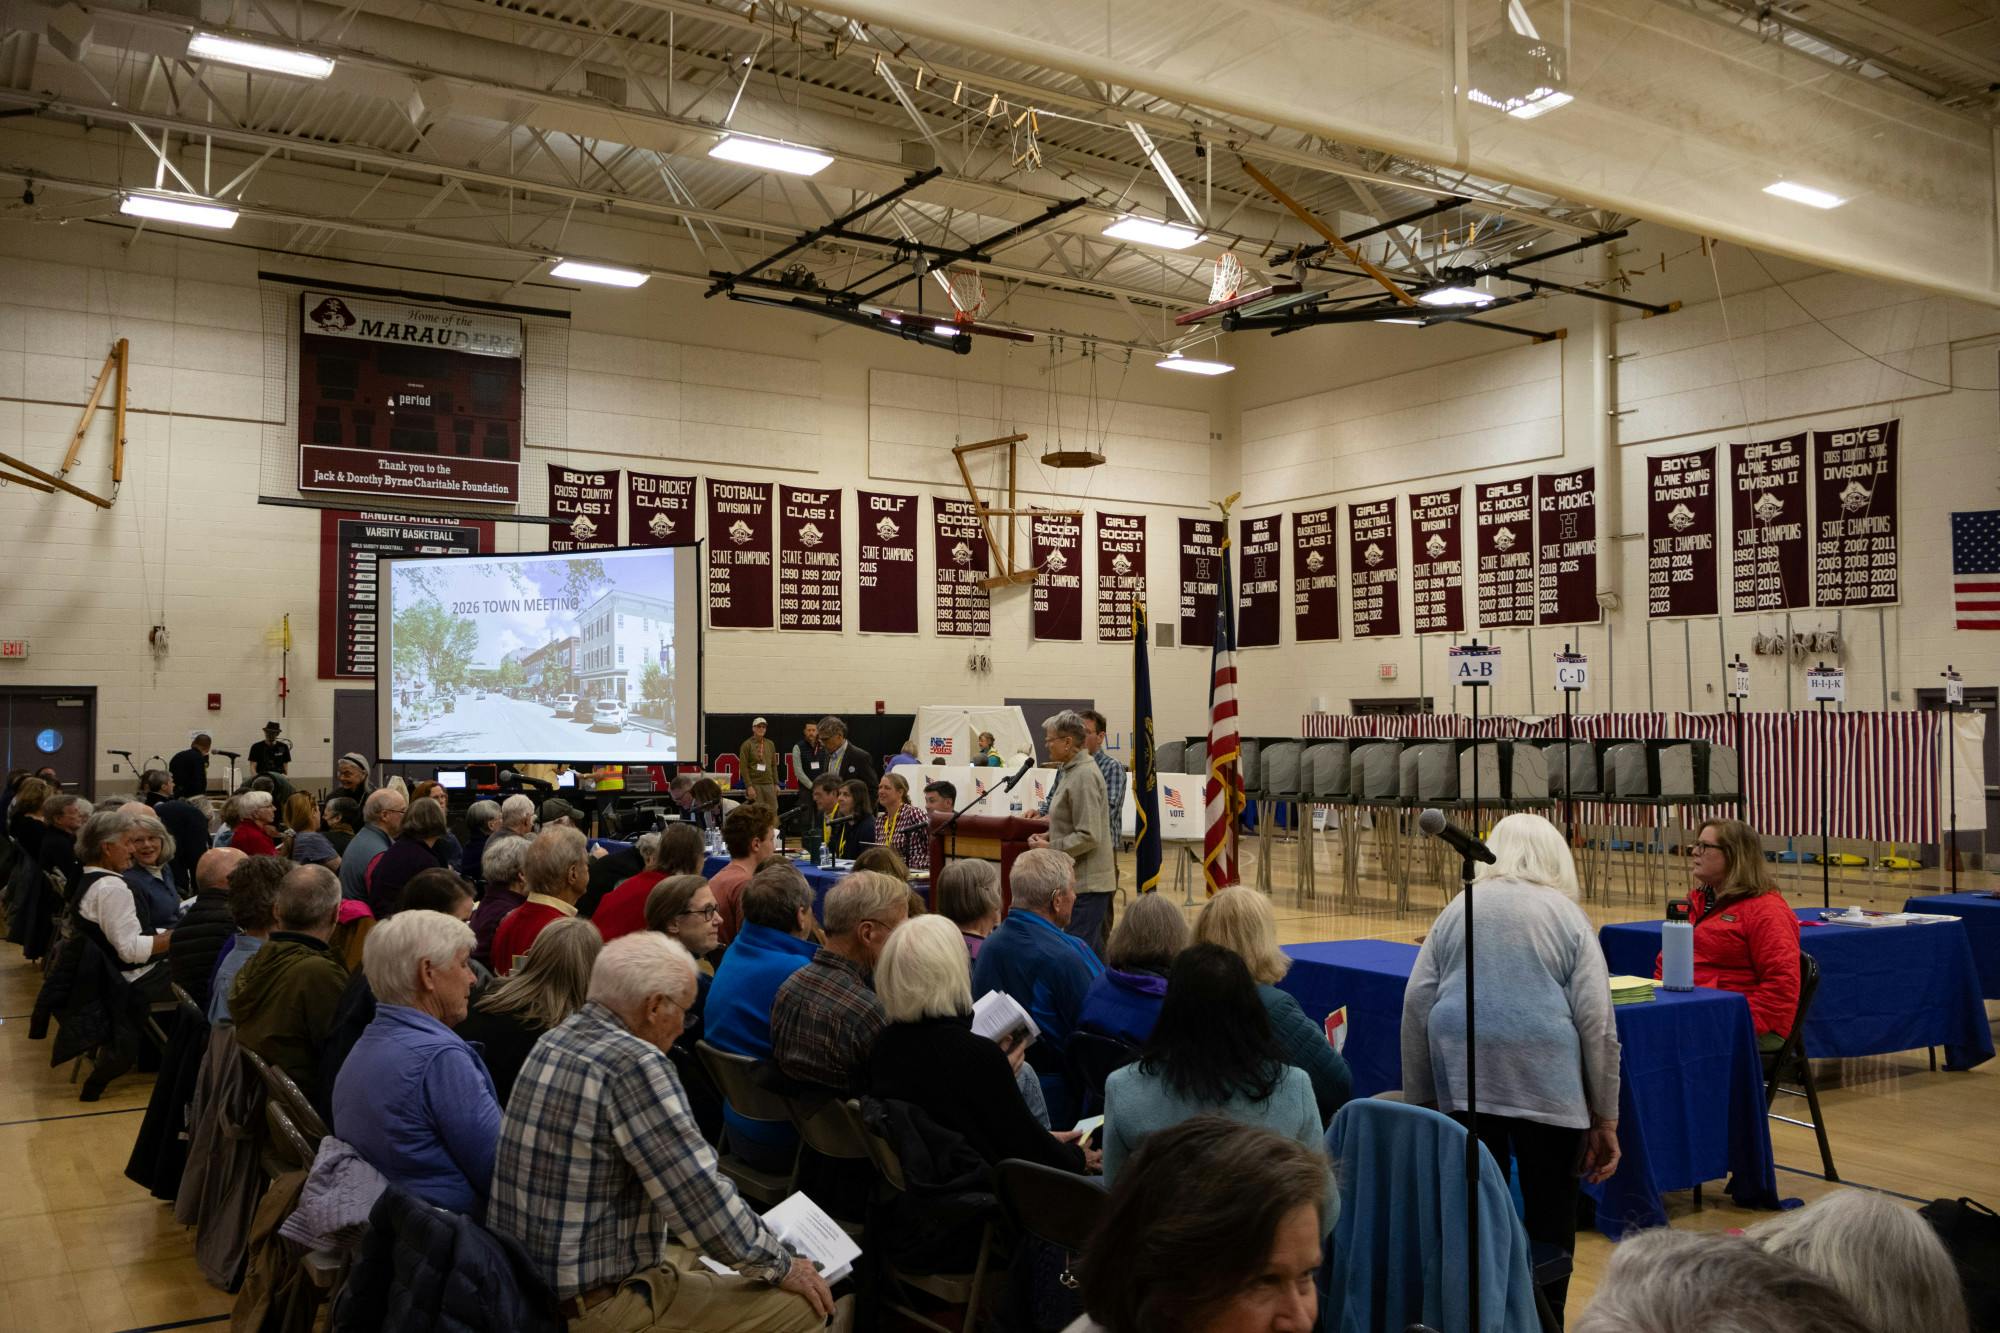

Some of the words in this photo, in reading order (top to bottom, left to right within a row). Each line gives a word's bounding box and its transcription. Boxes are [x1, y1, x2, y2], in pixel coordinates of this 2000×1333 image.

[408, 310, 439, 322] Home
[443, 316, 453, 326] of
[456, 316, 472, 326] the
[359, 319, 516, 353] MARAUDERS
[399, 394, 431, 406] period
[1831, 428, 1880, 447] BOYS
[1744, 441, 1792, 459] GIRLS
[378, 459, 406, 470] Thank
[409, 462, 424, 473] you
[426, 465, 435, 473] to
[437, 466, 451, 474] the
[1661, 455, 1701, 472] BOYS
[1737, 462, 1767, 476] ALPINE
[1772, 455, 1799, 472] SKIING
[1824, 463, 1874, 480] DIVISION
[1876, 460, 1888, 475] II
[314, 470, 335, 483] Jack
[337, 473, 344, 482] &
[347, 473, 382, 485] Dorothy
[384, 475, 413, 488] Byrne
[414, 478, 460, 490] Charitable
[462, 482, 509, 494] Foundation
[563, 472, 606, 485] BOYS
[1554, 474, 1582, 492] GIRLS
[1654, 473, 1681, 487] ALPINE
[1685, 469, 1710, 483] SKIING
[1739, 474, 1783, 491] DIVISION
[1787, 472, 1798, 485] II
[554, 486, 578, 498] CROSS
[581, 487, 613, 499] COUNTRY
[632, 477, 656, 493] FIELD
[659, 479, 691, 495] HOCKEY
[713, 484, 766, 501] FOOTBALL
[1486, 483, 1522, 498] GIRLS
[1655, 487, 1696, 502] DIVISION
[1699, 484, 1709, 497] II
[636, 497, 678, 509] CLASS
[681, 498, 688, 510] I
[792, 492, 829, 504] GOLF
[870, 496, 906, 511] GOLF
[1420, 494, 1451, 506] BOYS
[1480, 500, 1493, 511] ICE
[1495, 495, 1530, 510] HOCKEY
[1540, 496, 1555, 512] ICE
[1558, 491, 1595, 510] HOCKEY
[557, 501, 600, 514] CLASS
[604, 503, 610, 515] I
[717, 504, 750, 514] DIVISION
[753, 505, 762, 514] IV
[786, 506, 826, 519] CLASS
[829, 509, 835, 519] I
[1412, 509, 1425, 520] ICE
[1428, 504, 1459, 518] HOCKEY
[1105, 518, 1137, 528] GIRLS
[1301, 512, 1328, 524] BOYS
[1479, 513, 1493, 525] NEW
[1495, 509, 1530, 524] HAMPSHIRE
[1297, 524, 1331, 536] BASKETBALL
[1822, 521, 1845, 538] STATE
[1848, 515, 1890, 535] CHAMPIONS
[366, 527, 400, 537] VARSITY
[402, 529, 454, 541] BASKETBALL
[1099, 530, 1143, 540] SOCCER
[1299, 535, 1325, 548] CLASS
[1326, 534, 1331, 544] I
[552, 541, 573, 551] STATE
[1102, 542, 1133, 551] CLASS
[1136, 543, 1141, 552] I
[1542, 544, 1560, 559] STATE
[1563, 539, 1596, 557] CHAMPIONS
[1653, 537, 1672, 553] STATE
[1675, 534, 1712, 551] CHAMPIONS
[1817, 541, 1840, 554] 1992
[1844, 538, 1868, 552] 2007
[1871, 536, 1895, 550] 2011
[712, 550, 732, 564] STATE
[735, 551, 770, 565] CHAMPIONS
[782, 550, 802, 564] STATE
[805, 551, 839, 566] CHAMPIONS
[862, 546, 879, 560] STATE
[882, 547, 914, 562] CHAMPIONS
[1481, 556, 1497, 570] STATE
[1500, 552, 1530, 567] CHAMPIONS
[860, 562, 877, 572] 2015
[1540, 563, 1557, 575] 2018
[1560, 560, 1579, 573] 2025
[1650, 557, 1670, 569] 2009
[1672, 555, 1693, 567] 2024
[1817, 557, 1842, 571] 2003
[1844, 554, 1869, 568] 2008
[1871, 552, 1896, 566] 2019
[710, 568, 730, 579] 2002
[781, 568, 799, 580] 1990
[801, 569, 819, 580] 1999
[822, 569, 841, 580] 2007
[1479, 573, 1496, 583] 2005
[1497, 571, 1514, 581] 2010
[1516, 568, 1532, 579] 2014
[1650, 571, 1669, 583] 2021
[1672, 569, 1693, 581] 2025
[1817, 572, 1842, 586] 2004
[1845, 571, 1869, 584] 2009
[1871, 568, 1896, 582] 2020
[711, 583, 730, 593] 2004
[860, 576, 877, 586] 2017
[1099, 576, 1116, 588] STATE
[1540, 576, 1557, 588] 2019
[781, 583, 798, 594] 1991
[801, 584, 820, 595] 2000
[822, 584, 838, 596] 2011
[1479, 586, 1496, 597] 2006
[1497, 584, 1512, 594] 2011
[1516, 582, 1533, 593] 2015
[1540, 590, 1557, 601] 2022
[1650, 586, 1670, 598] 2022
[1817, 588, 1842, 601] 2006
[1845, 586, 1868, 599] 2010
[1871, 584, 1895, 597] 2021
[453, 602, 479, 614] 2026
[483, 600, 520, 613] TOWN
[524, 598, 578, 611] MEETING
[711, 597, 731, 608] 2005
[781, 598, 799, 609] 1993
[801, 599, 820, 610] 2004
[822, 600, 840, 611] 2012
[1479, 600, 1496, 610] 2007
[1498, 597, 1513, 608] 2012
[1515, 596, 1533, 606] 2016
[1540, 603, 1558, 614] 2024
[1650, 601, 1670, 613] 2023
[781, 613, 799, 624] 1997
[801, 614, 820, 625] 2006
[822, 614, 840, 625] 2014
[1099, 615, 1114, 624] 2002
[1116, 615, 1131, 624] 2014
[1099, 628, 1115, 637] 2004
[1117, 628, 1131, 637] 2015
[3, 642, 22, 656] EXIT
